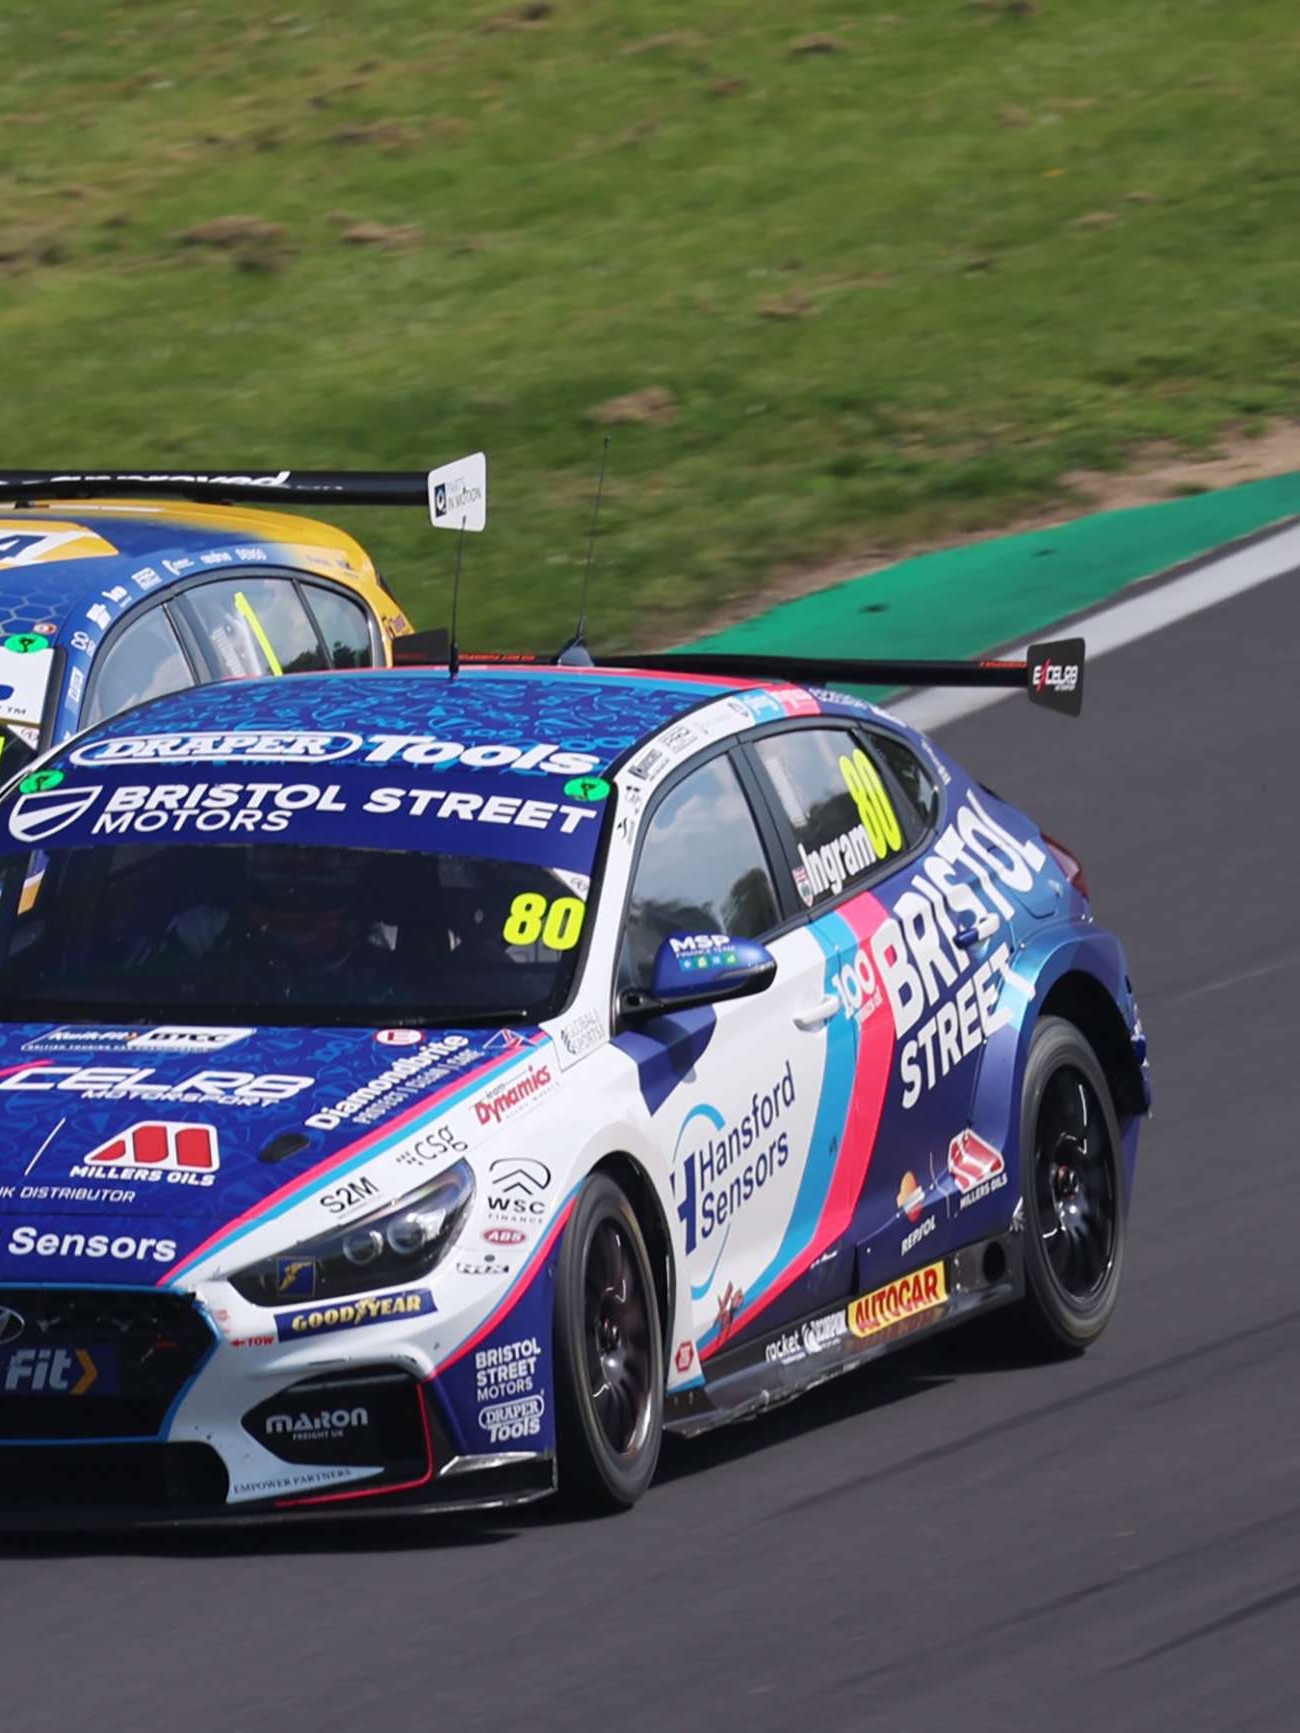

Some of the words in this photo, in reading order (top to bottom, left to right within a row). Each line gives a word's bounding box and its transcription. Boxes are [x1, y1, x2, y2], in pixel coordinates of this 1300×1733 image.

[94, 735, 333, 760] DRAPER
[365, 735, 600, 775] Tools
[104, 783, 348, 812] BRISTOL
[362, 787, 598, 834] STREET
[838, 748, 902, 860] 80
[90, 809, 293, 835] MOTORS
[797, 823, 877, 896] Ingram
[502, 892, 586, 950] 80
[870, 788, 1046, 1040] BRISTOL
[669, 934, 731, 953] MSP
[900, 941, 1037, 1110] STREET
[80, 1088, 281, 1108] MOTORSPORT
[304, 1034, 469, 1131] Diamondbrite
[474, 1064, 552, 1126] Dynamics
[699, 1058, 796, 1192] Hansford
[69, 1165, 162, 1186] MILLERS
[166, 1169, 216, 1187] OILS
[700, 1131, 789, 1240] Sensors
[19, 1186, 137, 1204] DISTRIBUTOR
[319, 1175, 381, 1215] S2M
[487, 1196, 546, 1215] WSC
[8, 1226, 177, 1262] Sensors
[901, 1214, 936, 1257] REPSOL
[291, 1296, 421, 1331] GOODYEAR
[854, 1267, 939, 1334] AUTOCAR
[246, 1336, 274, 1347] TOW
[475, 1337, 542, 1370] BRISTOL
[765, 1330, 801, 1363] rocket
[4, 1348, 73, 1391] Fit
[476, 1356, 537, 1387] STREET
[477, 1376, 533, 1402] MOTORS
[485, 1399, 540, 1424] DRAPER
[292, 1430, 329, 1440] FREIGHT
[331, 1429, 344, 1438] UK
[490, 1417, 541, 1443] Tools
[233, 1478, 291, 1494] EMPOWER
[293, 1469, 352, 1486] PARTNERS
